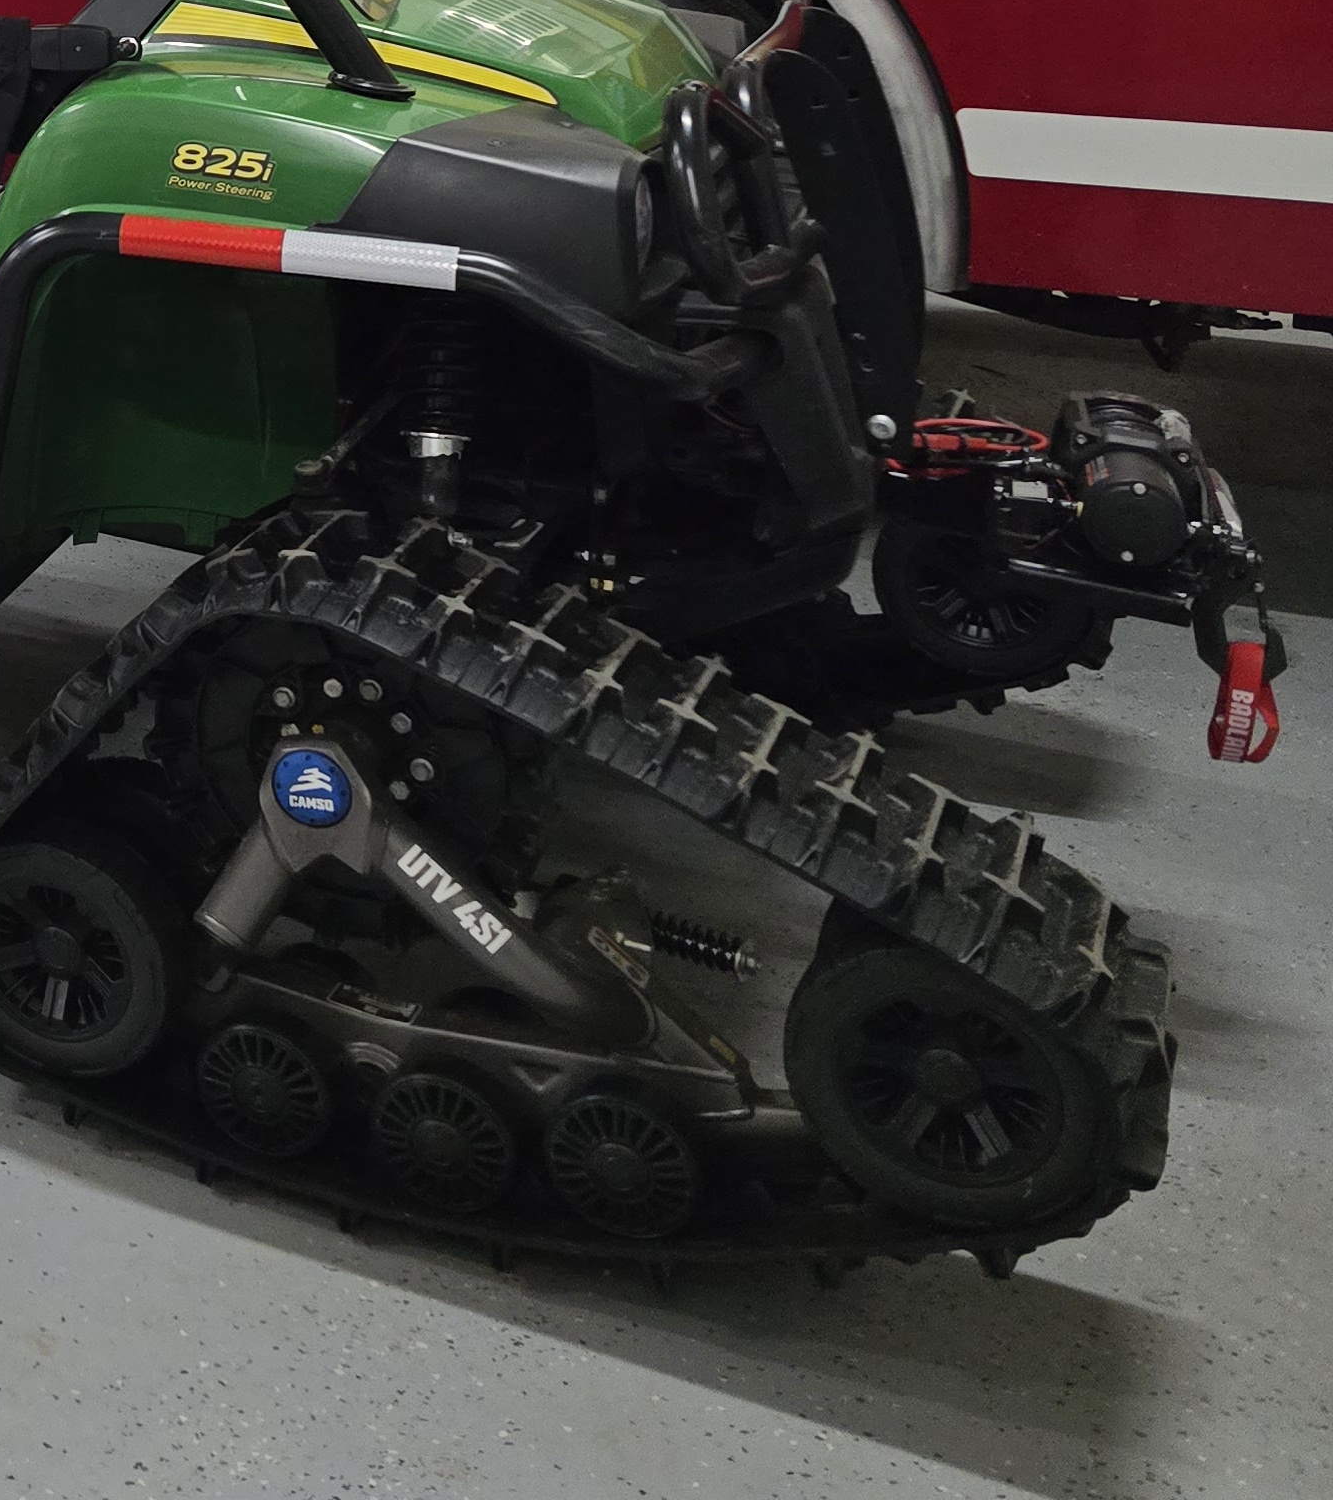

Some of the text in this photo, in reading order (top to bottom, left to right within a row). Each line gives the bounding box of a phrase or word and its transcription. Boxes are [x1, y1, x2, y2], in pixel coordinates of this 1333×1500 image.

[172, 142, 275, 183] 825i
[167, 175, 274, 202] Power Steering
[289, 794, 335, 812] CAMSO
[397, 843, 513, 955] UTV 4S1
